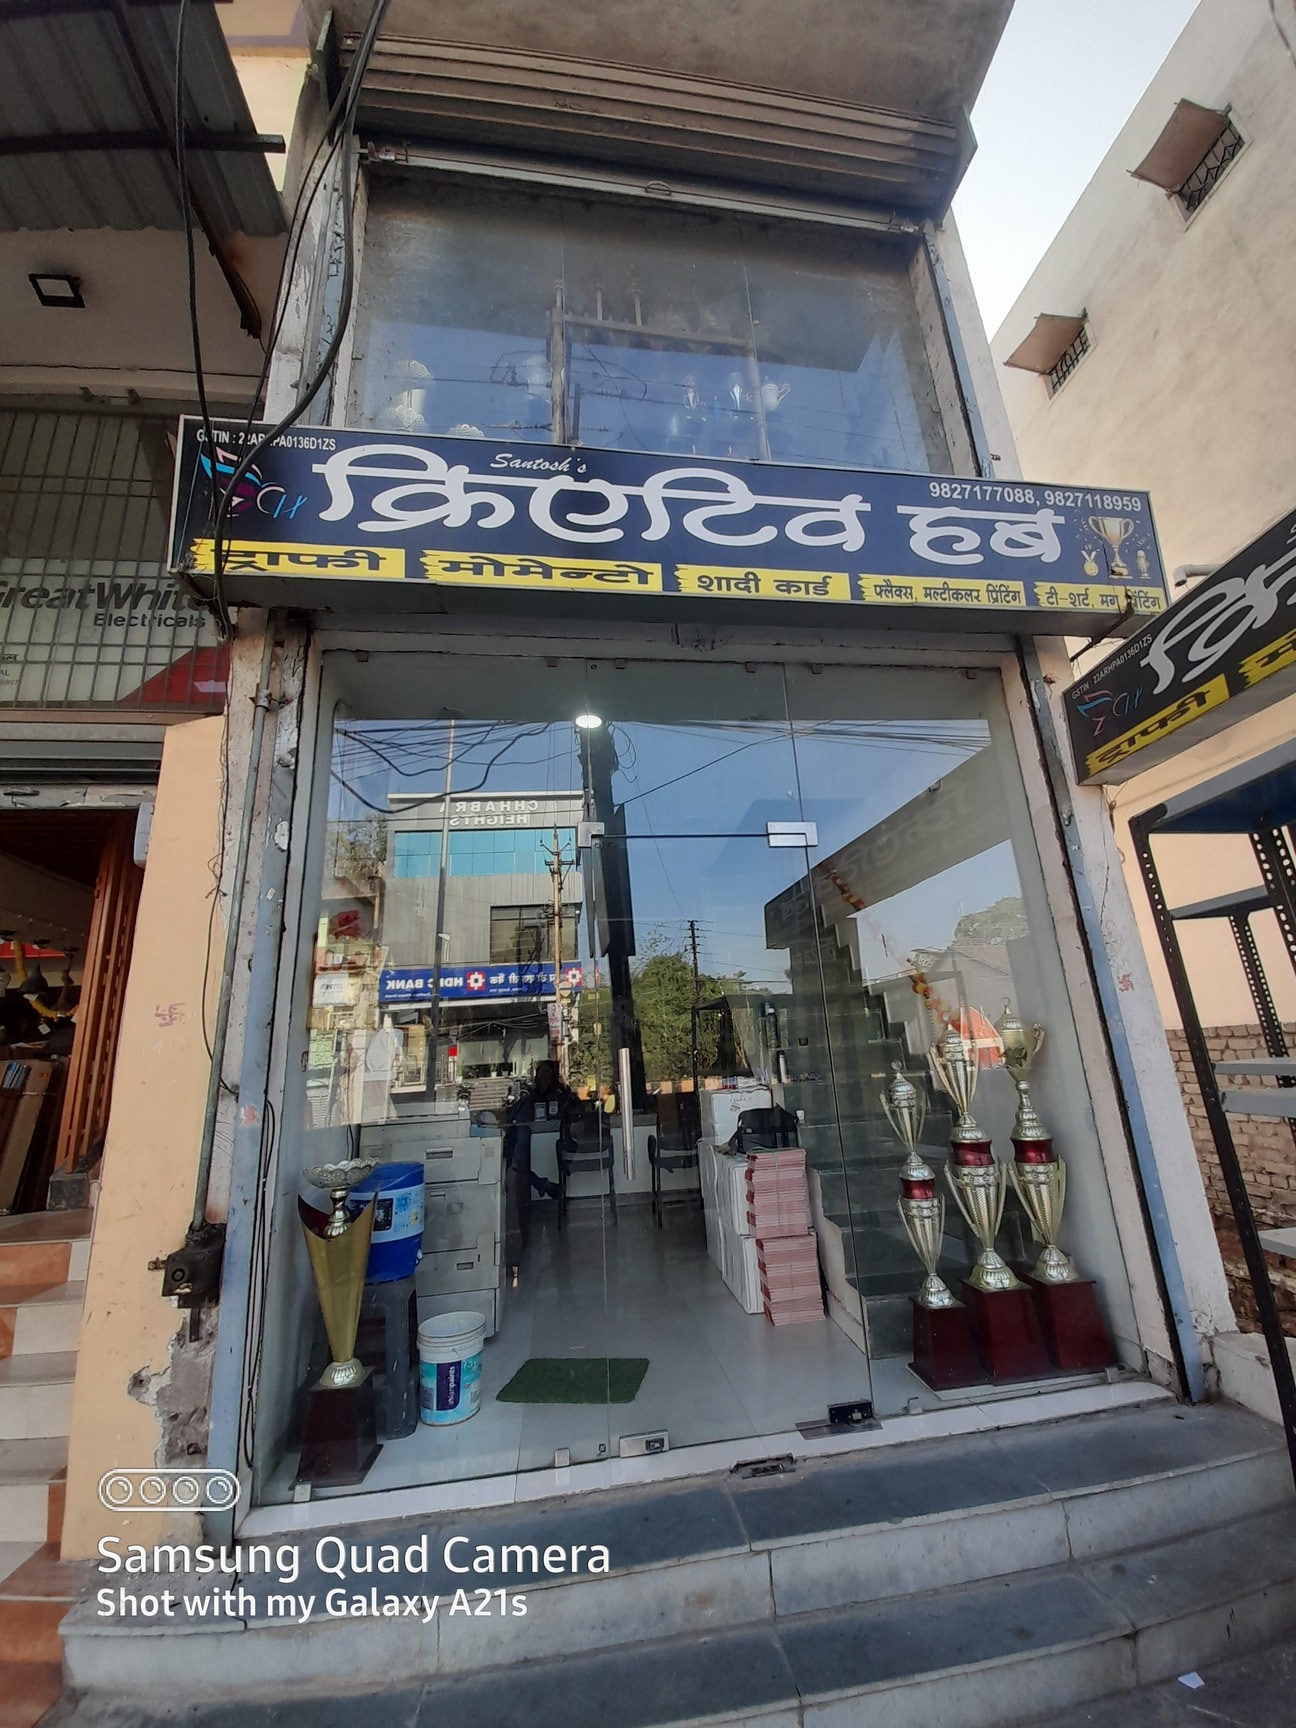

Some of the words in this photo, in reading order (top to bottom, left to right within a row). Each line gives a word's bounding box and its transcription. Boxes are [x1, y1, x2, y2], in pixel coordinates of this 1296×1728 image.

[196, 429, 230, 443] GTIN
[238, 431, 336, 450] 2ARPA0136D1ZS
[490, 453, 587, 474] Santosh's
[929, 482, 1040, 506] 9827177088,
[1044, 490, 1142, 512] 9827118959
[896, 505, 1066, 566] हब
[697, 571, 762, 593] शादी
[773, 575, 832, 596] कार्ड
[923, 581, 981, 603] मल्टीकलर
[1098, 593, 1119, 608] मग
